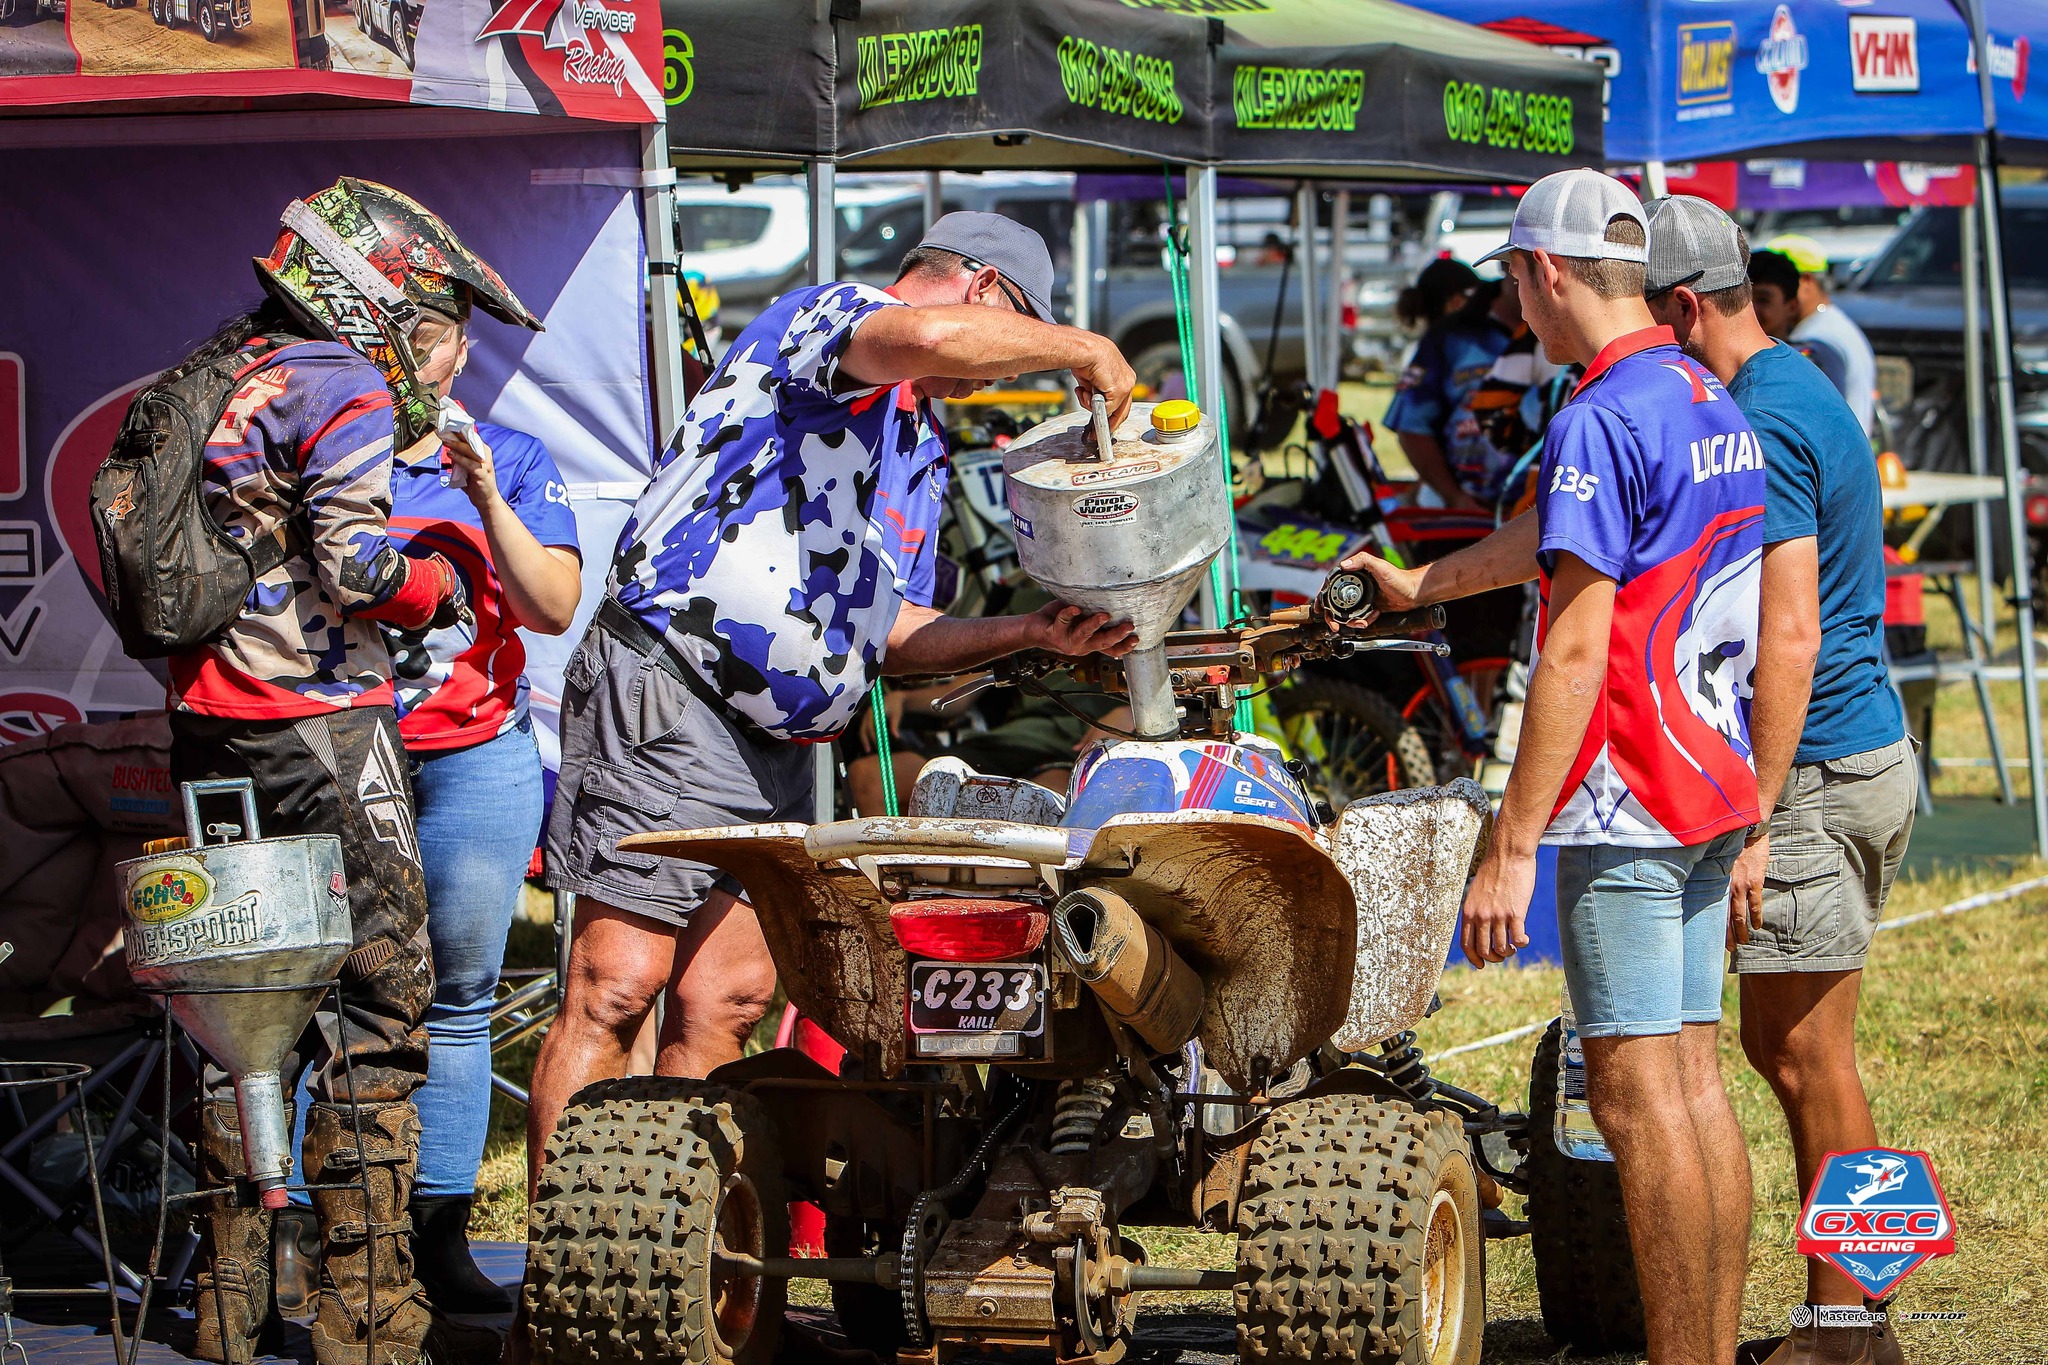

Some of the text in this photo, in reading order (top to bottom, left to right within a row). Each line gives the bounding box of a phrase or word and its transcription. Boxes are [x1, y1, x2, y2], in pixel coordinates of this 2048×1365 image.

[573, 2, 637, 33] Vervoer
[564, 37, 627, 98] Racing
[857, 23, 983, 110] KLERKSDORP
[1057, 35, 1099, 108] 018
[1853, 32, 1914, 77] VHM
[1233, 65, 1365, 131] KLERKSDORP
[1443, 80, 1574, 156] 018 464 3896
[1079, 502, 1133, 514] Works
[1084, 494, 1126, 507] Pivot
[1260, 523, 1347, 563] 444
[1268, 764, 1306, 805] SUZU
[133, 879, 187, 911] ECHO
[150, 904, 177, 915] CENTRE
[924, 969, 1033, 1011] C233
[958, 1015, 996, 1029] KAILI
